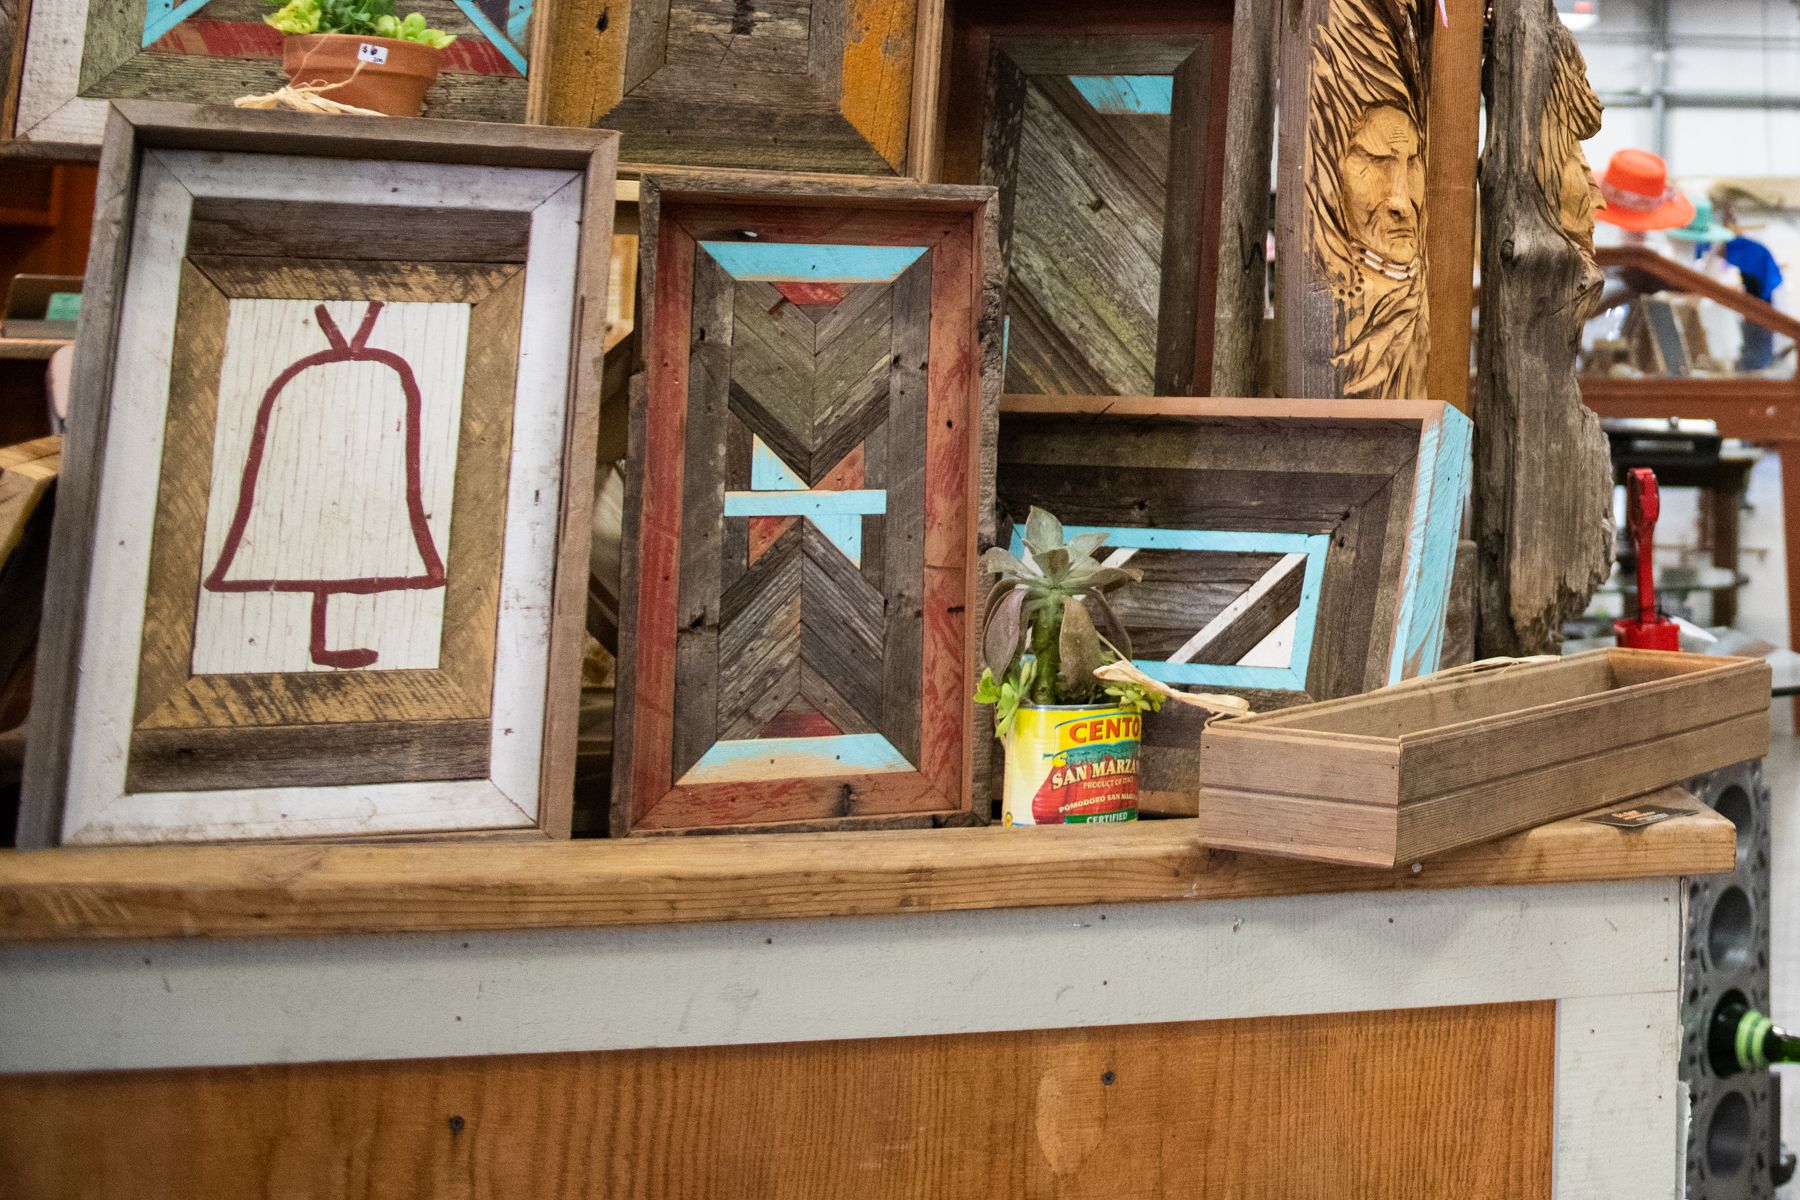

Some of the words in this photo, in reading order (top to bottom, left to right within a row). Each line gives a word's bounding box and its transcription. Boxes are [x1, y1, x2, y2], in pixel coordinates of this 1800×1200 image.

[1069, 717, 1139, 743] CENTO
[1052, 765, 1087, 789] SAN
[1092, 759, 1137, 778] MARZA
[1083, 779, 1114, 789] PRODUCT
[1059, 796, 1105, 812] POMODORO
[1106, 793, 1120, 801] SAN
[1086, 811, 1128, 824] CERTIFIED
